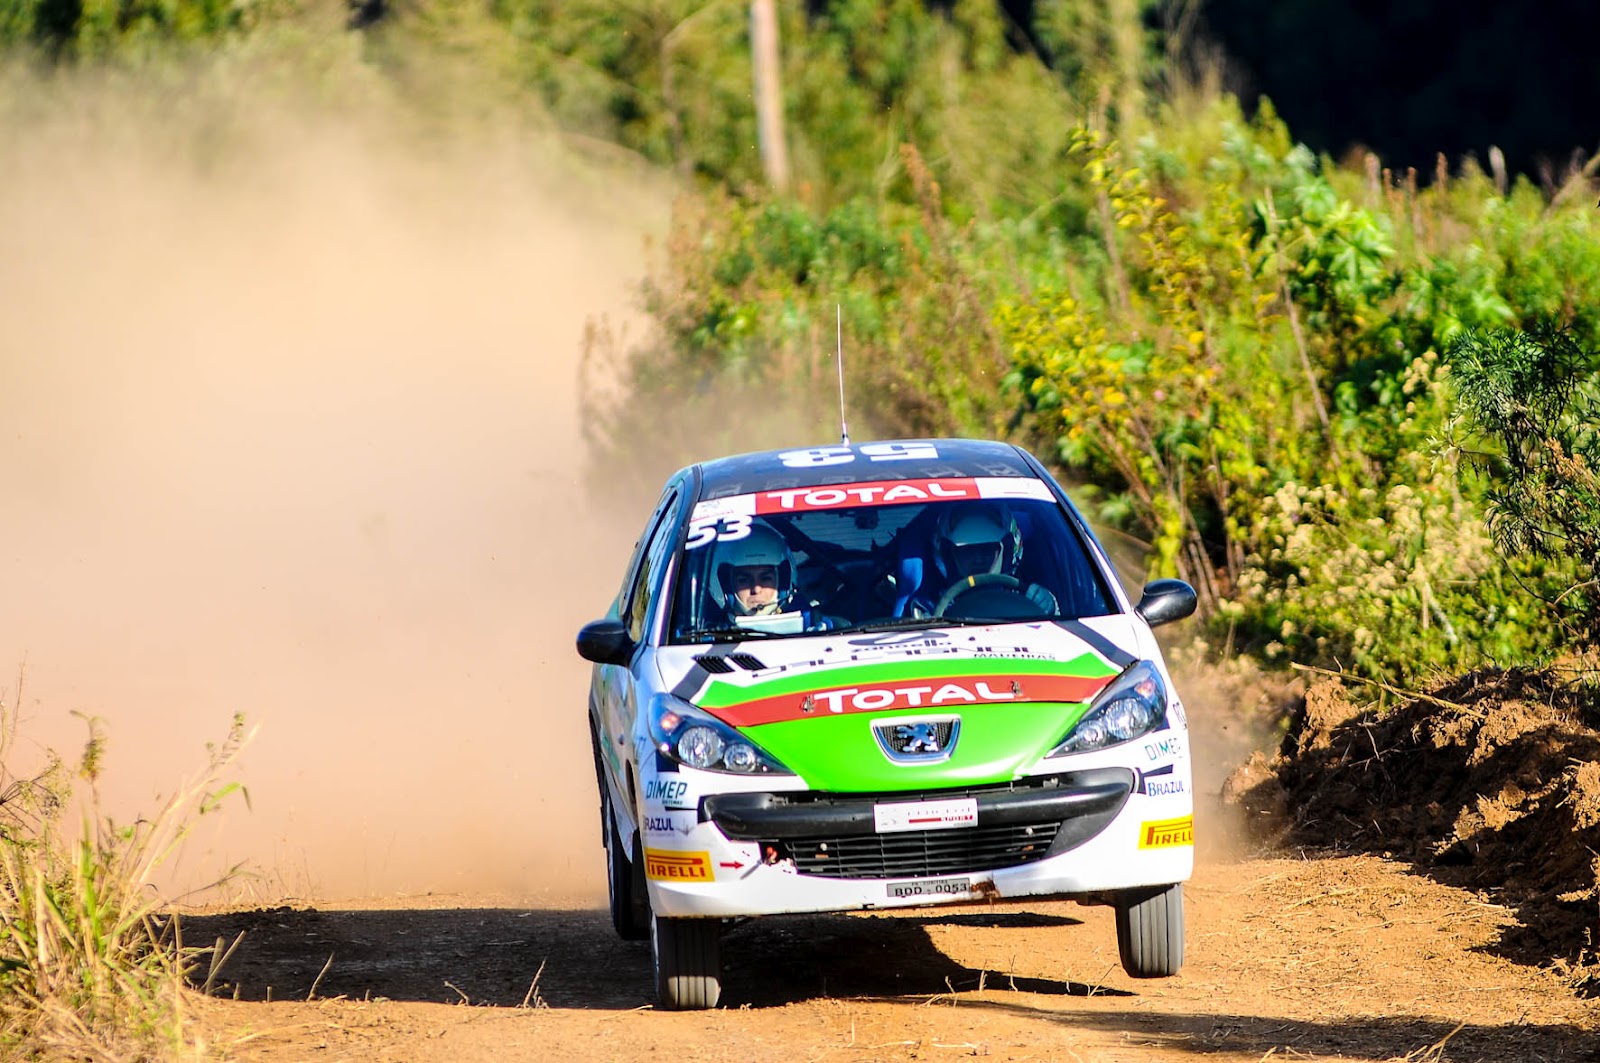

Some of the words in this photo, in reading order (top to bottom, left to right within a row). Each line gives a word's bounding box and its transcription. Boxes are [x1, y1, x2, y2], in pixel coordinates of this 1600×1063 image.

[766, 483, 967, 509] TOTAL
[685, 514, 753, 550] 53
[813, 682, 1015, 713] TOTAL
[646, 781, 688, 799] DIMEP
[1147, 780, 1184, 797] BRAZUL
[1145, 820, 1193, 845] PIRELL
[647, 854, 705, 878] PIRELLI
